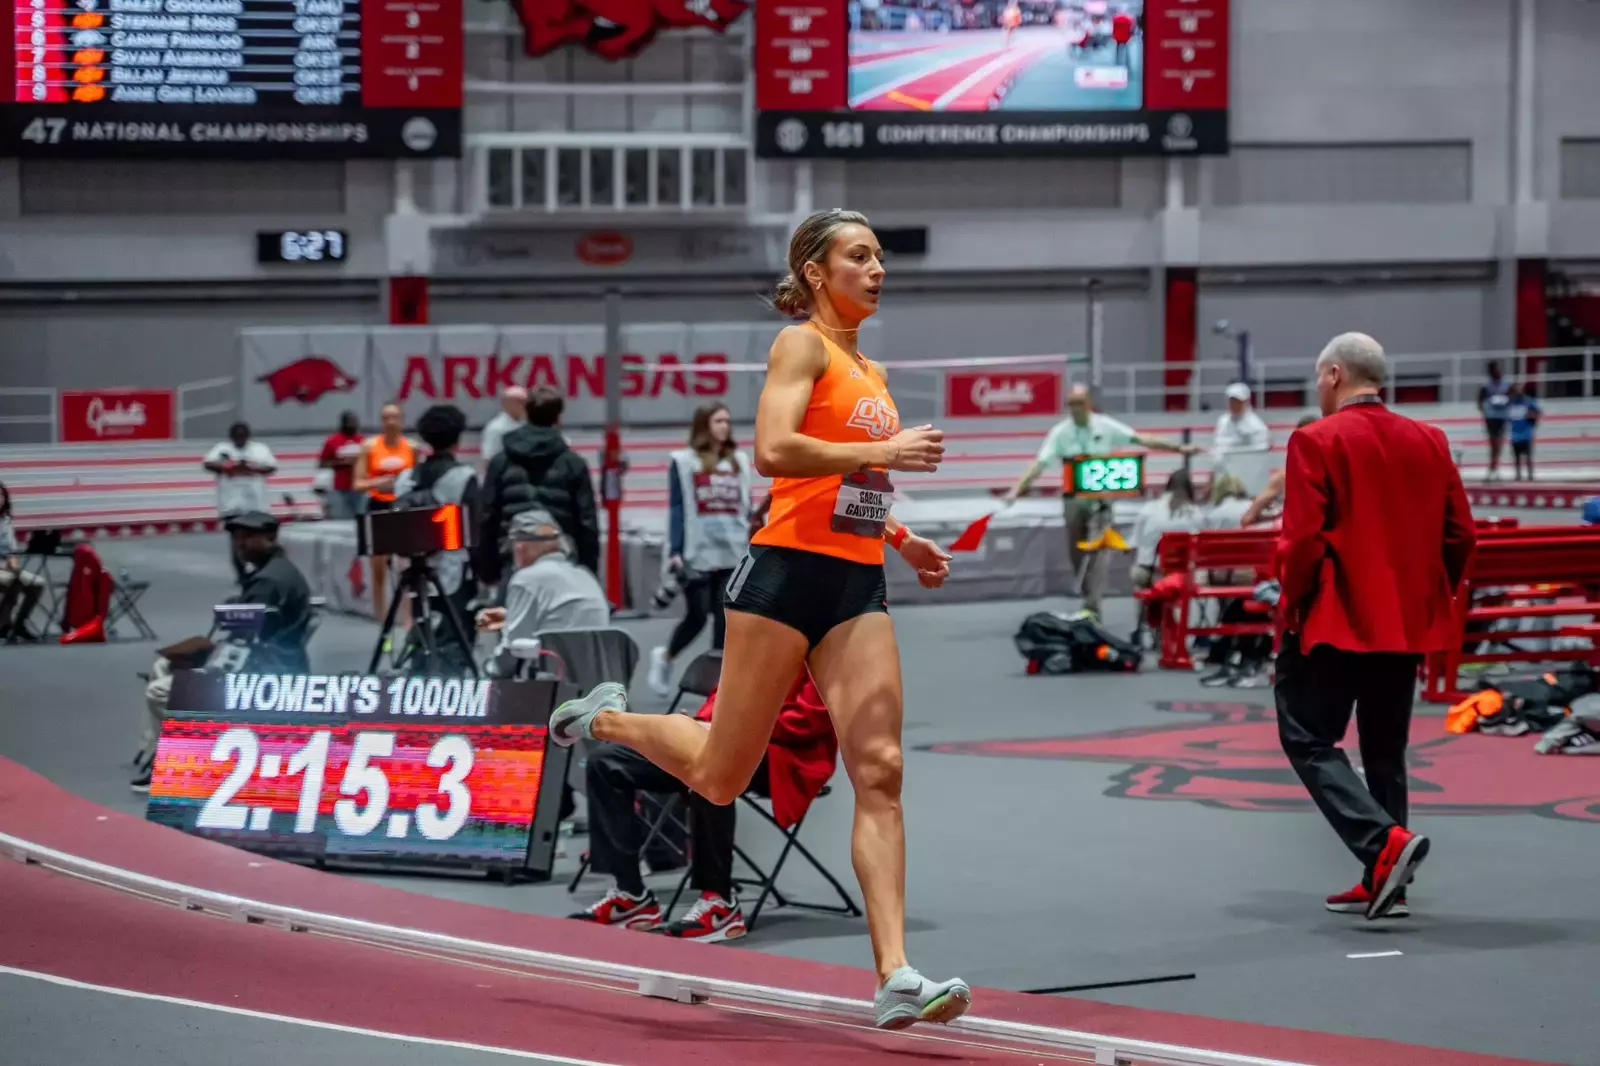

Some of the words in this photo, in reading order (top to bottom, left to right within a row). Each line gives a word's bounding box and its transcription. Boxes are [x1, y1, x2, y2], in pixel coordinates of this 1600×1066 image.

[21, 117, 68, 144] 47
[72, 121, 185, 142] NATIONAL
[190, 122, 368, 143] CHAMPIONSHIPS
[876, 123, 999, 144] CONFERENCE
[1000, 123, 1149, 143] CHAMPIONSHIPS
[399, 353, 728, 400] ARKANSAS
[431, 503, 462, 550] 1
[224, 673, 380, 714] WOMEN'S
[387, 677, 492, 717] 1000M
[195, 727, 475, 841] 2:15.3
